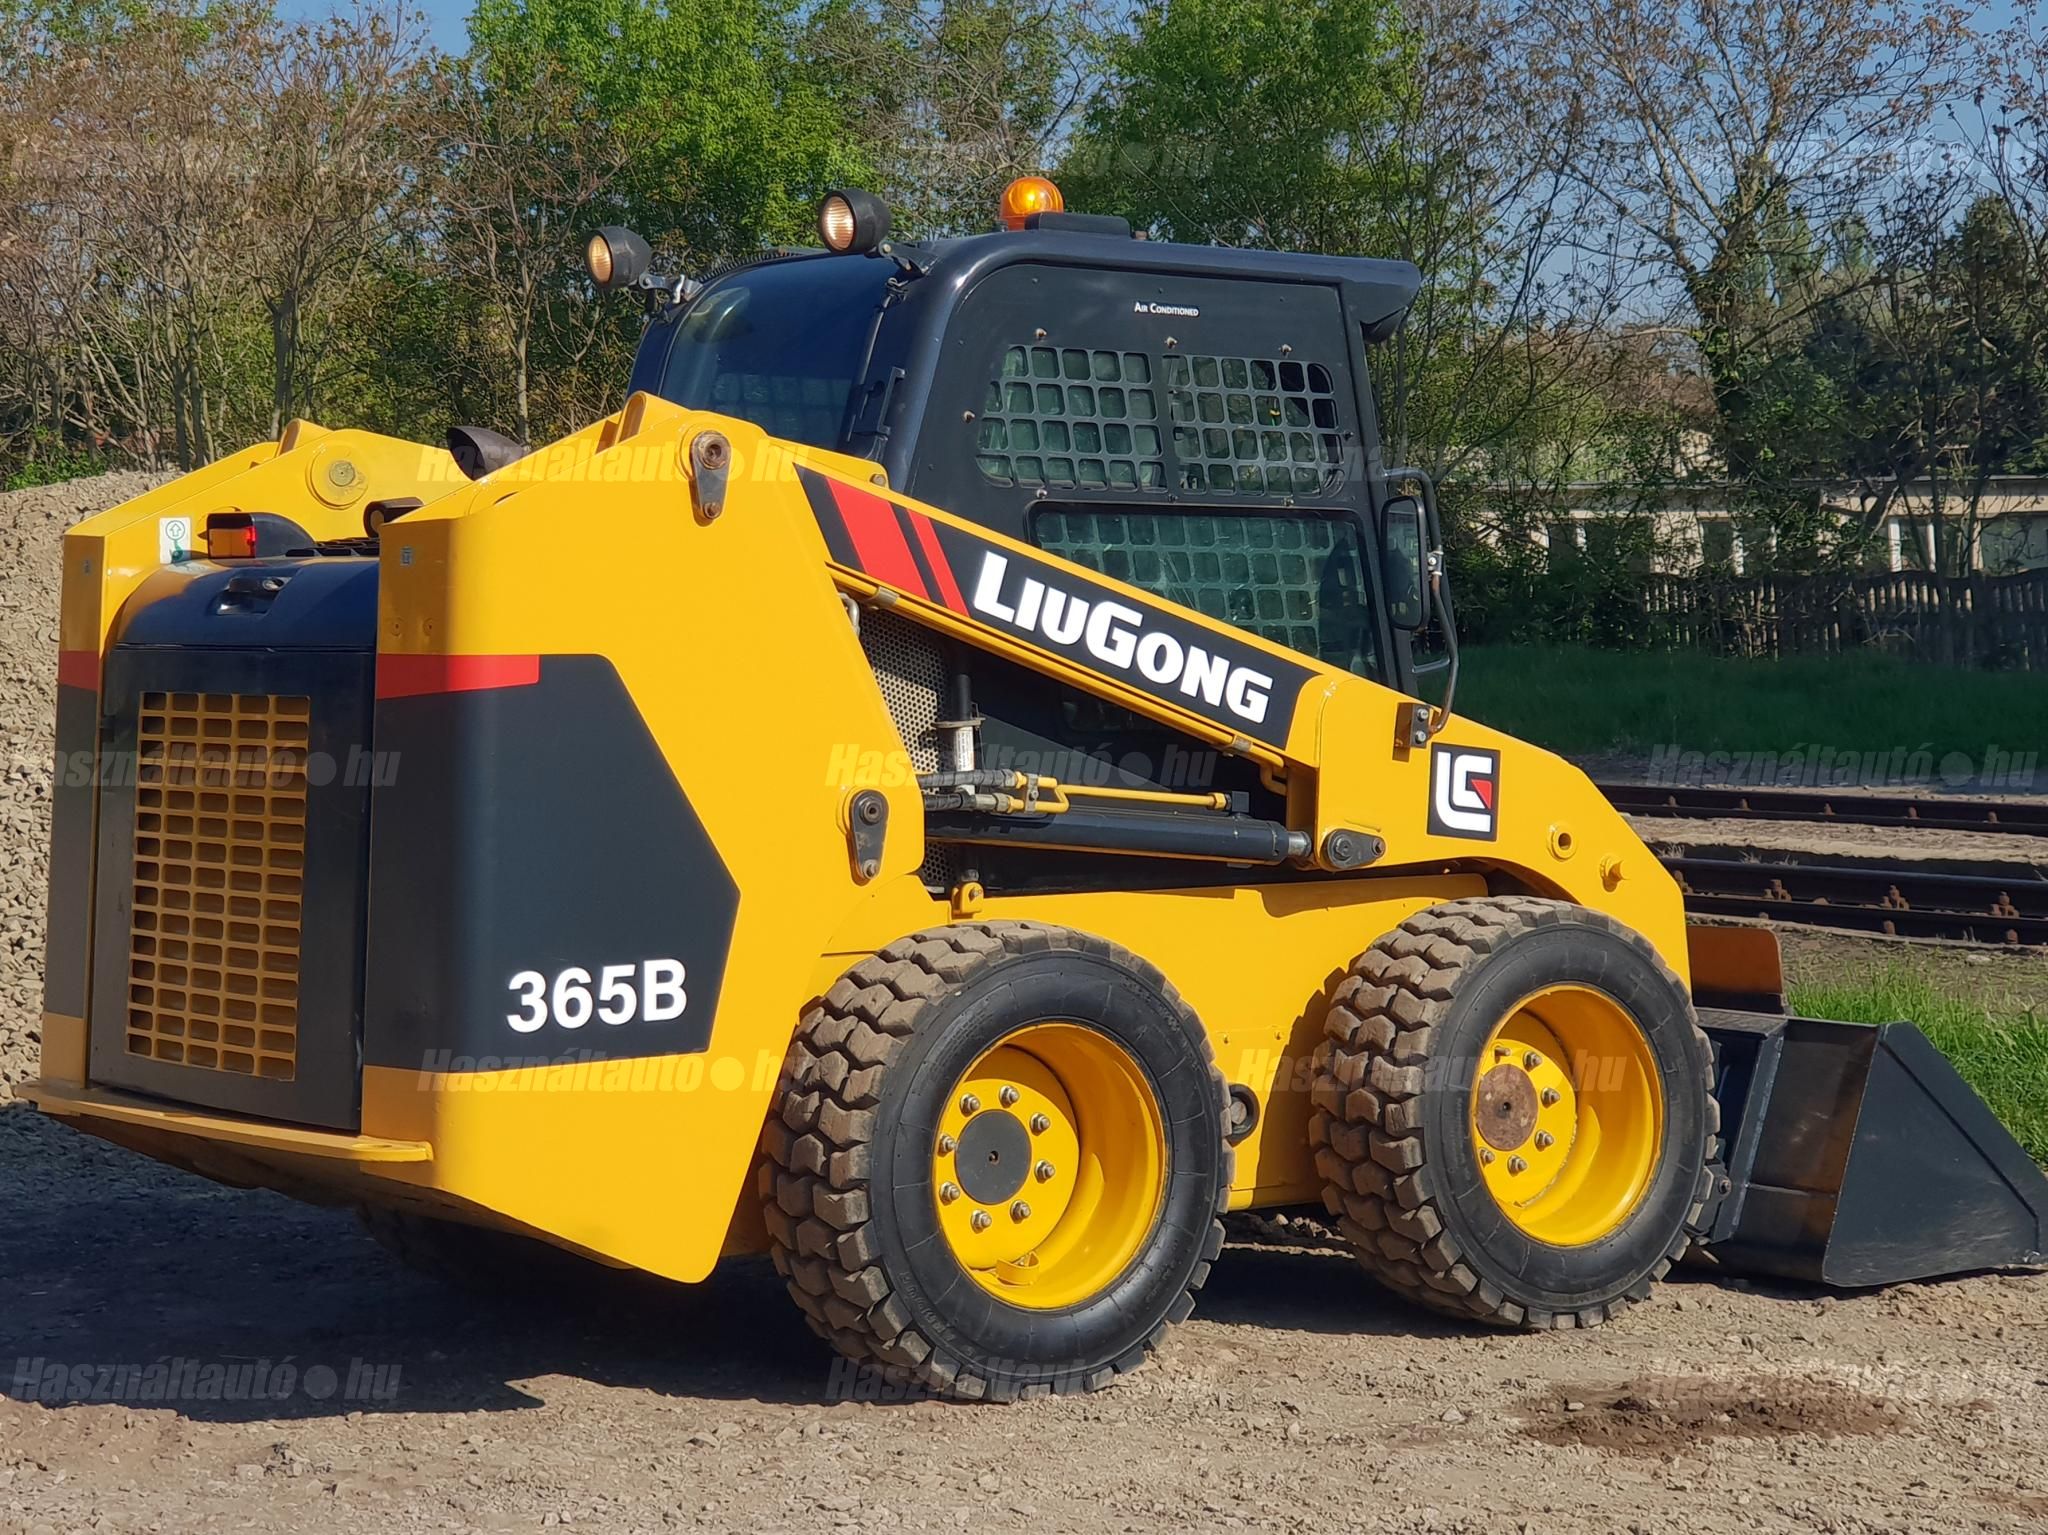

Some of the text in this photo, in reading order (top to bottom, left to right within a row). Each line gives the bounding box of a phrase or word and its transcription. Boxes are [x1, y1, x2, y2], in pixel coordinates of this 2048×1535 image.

[1150, 302, 1199, 317] CONDITIONED
[973, 550, 1273, 724] LIUGONG
[506, 958, 687, 1033] 365B
